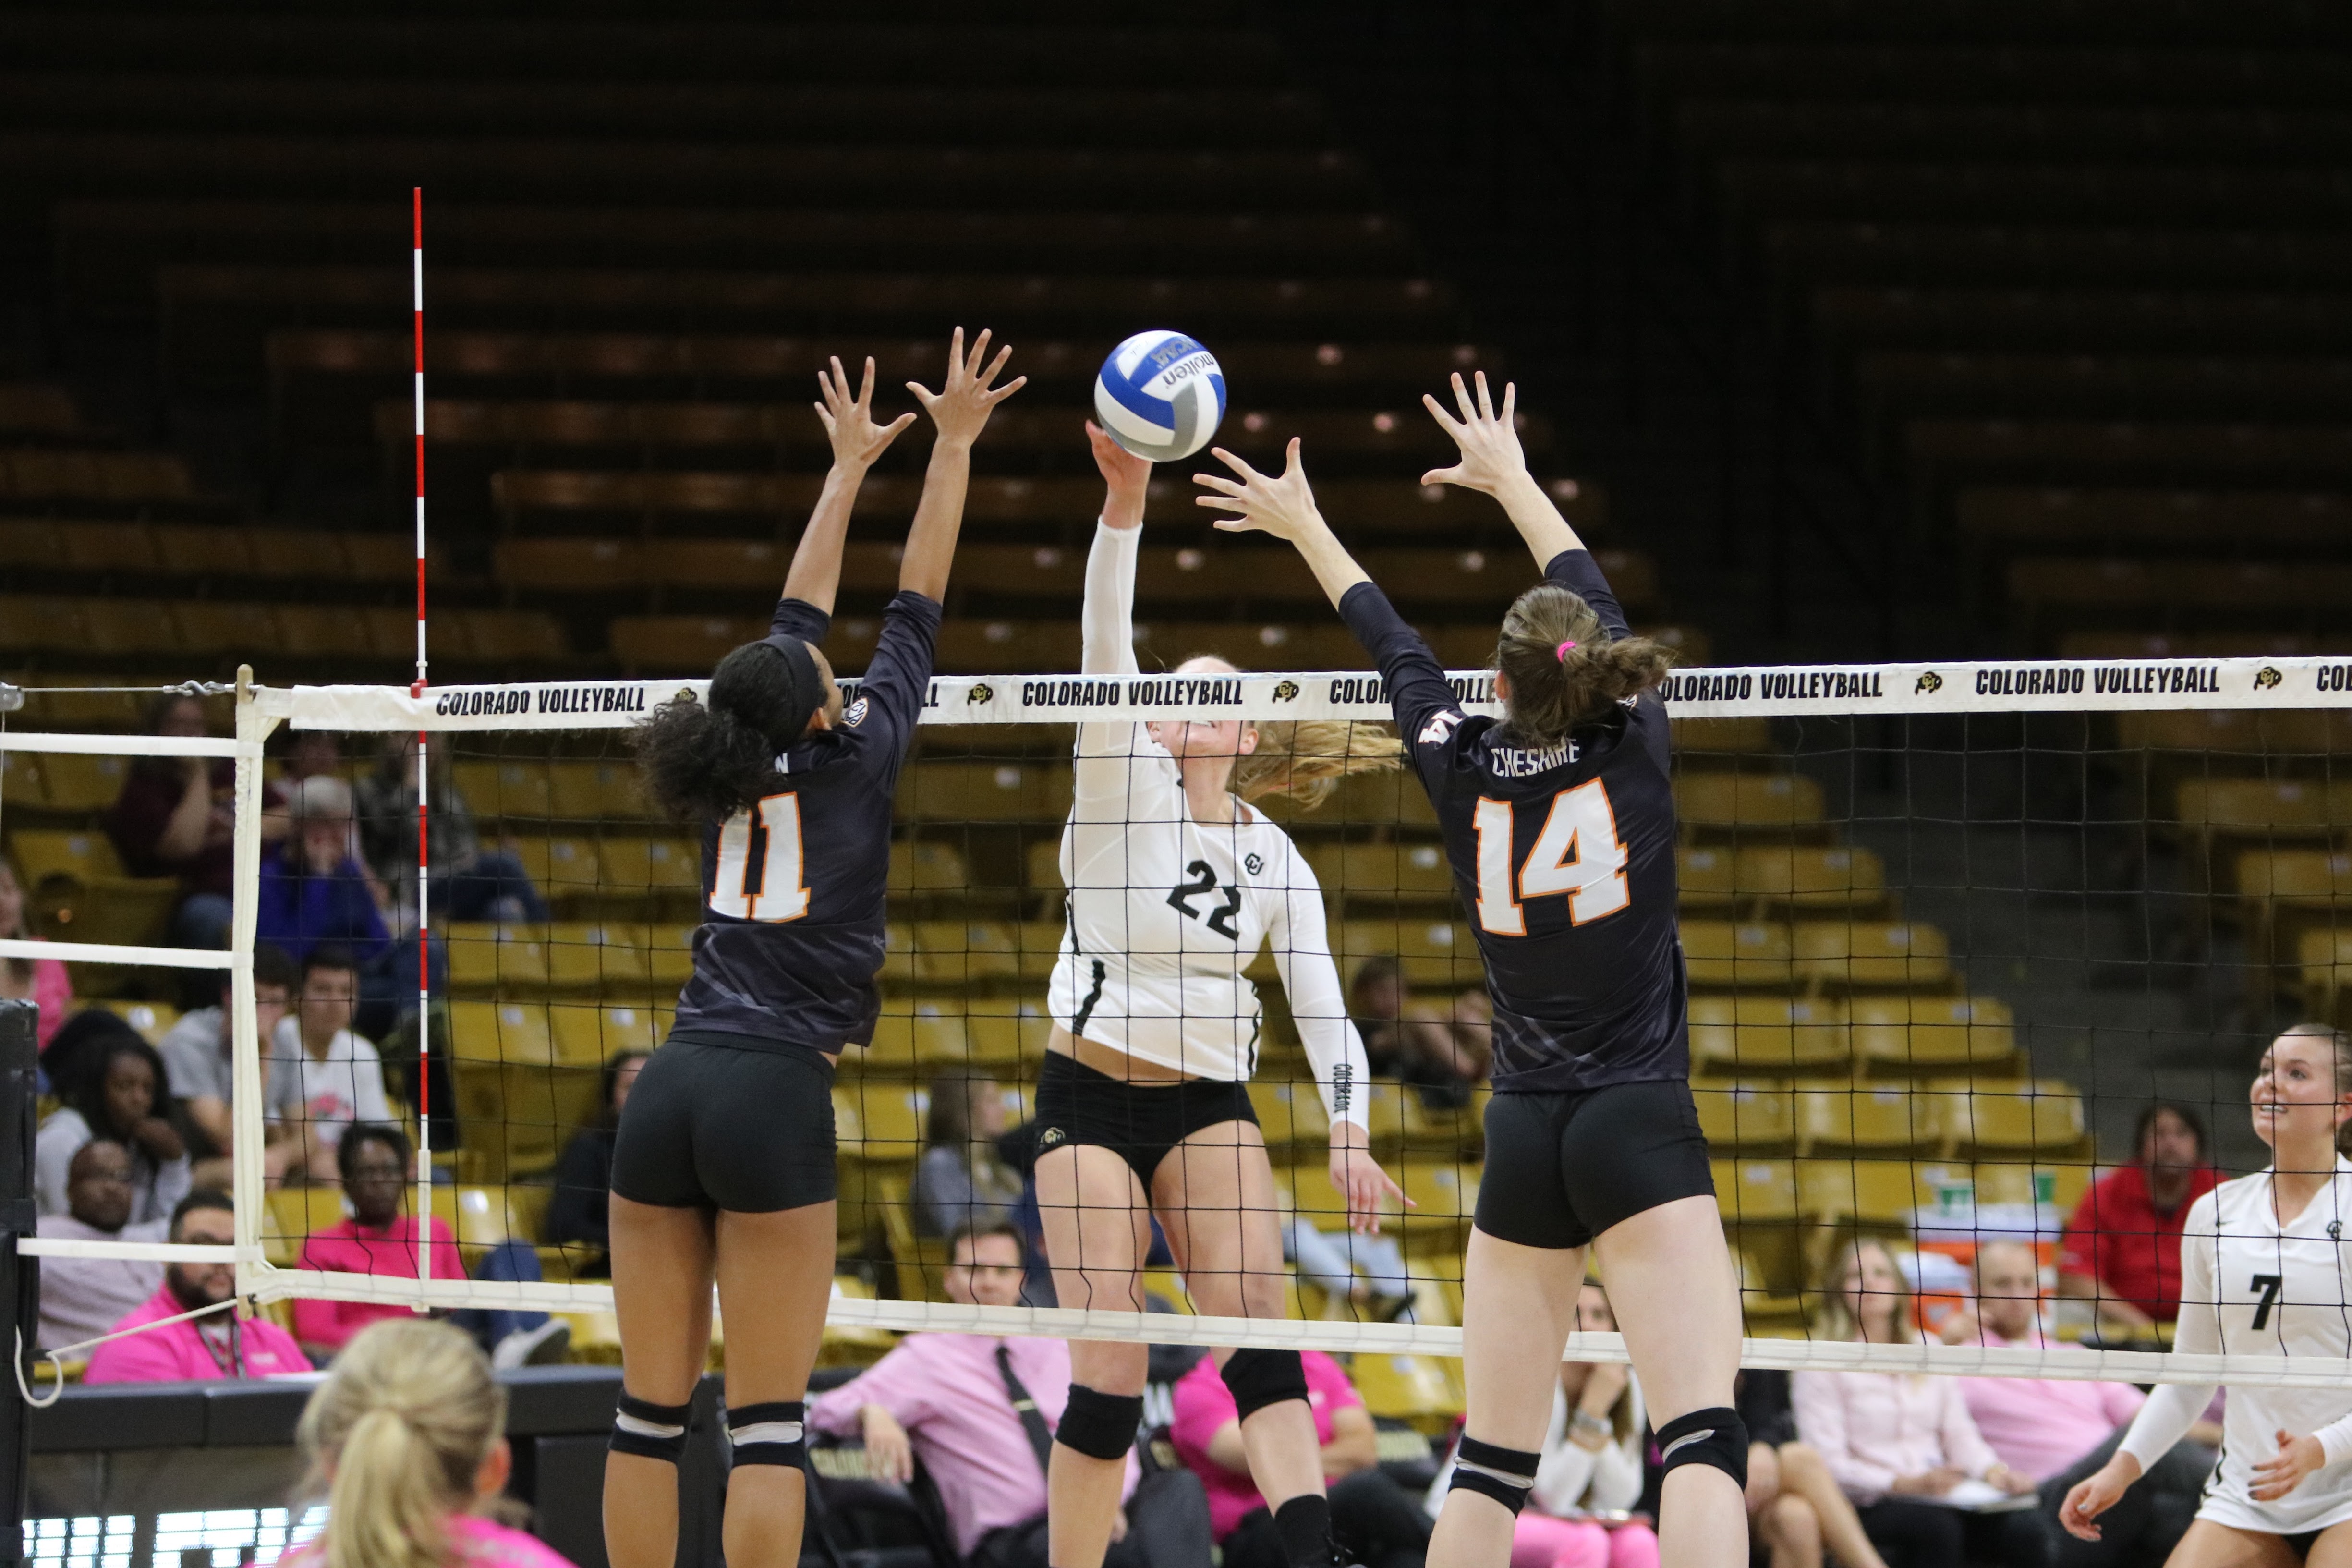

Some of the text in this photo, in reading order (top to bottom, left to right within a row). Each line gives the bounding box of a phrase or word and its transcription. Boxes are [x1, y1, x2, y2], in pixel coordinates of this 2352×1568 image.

[1162, 353, 1215, 385] molten
[1022, 680, 1243, 706] COLORADO VOLLEYBALL
[1661, 674, 1752, 702] OLORADO
[1761, 673, 1882, 699] VOLLEYBALL
[1976, 667, 2219, 695] COLORADO VOLLEYBALL
[436, 688, 645, 716] COLORADO VOLLEYBALL
[1418, 710, 1463, 745] 14
[1491, 737, 1580, 777] CHESHIRE
[709, 791, 812, 923] 11
[1472, 777, 1630, 936] 14
[1166, 860, 1241, 941] 22
[2250, 1274, 2282, 1330] 7
